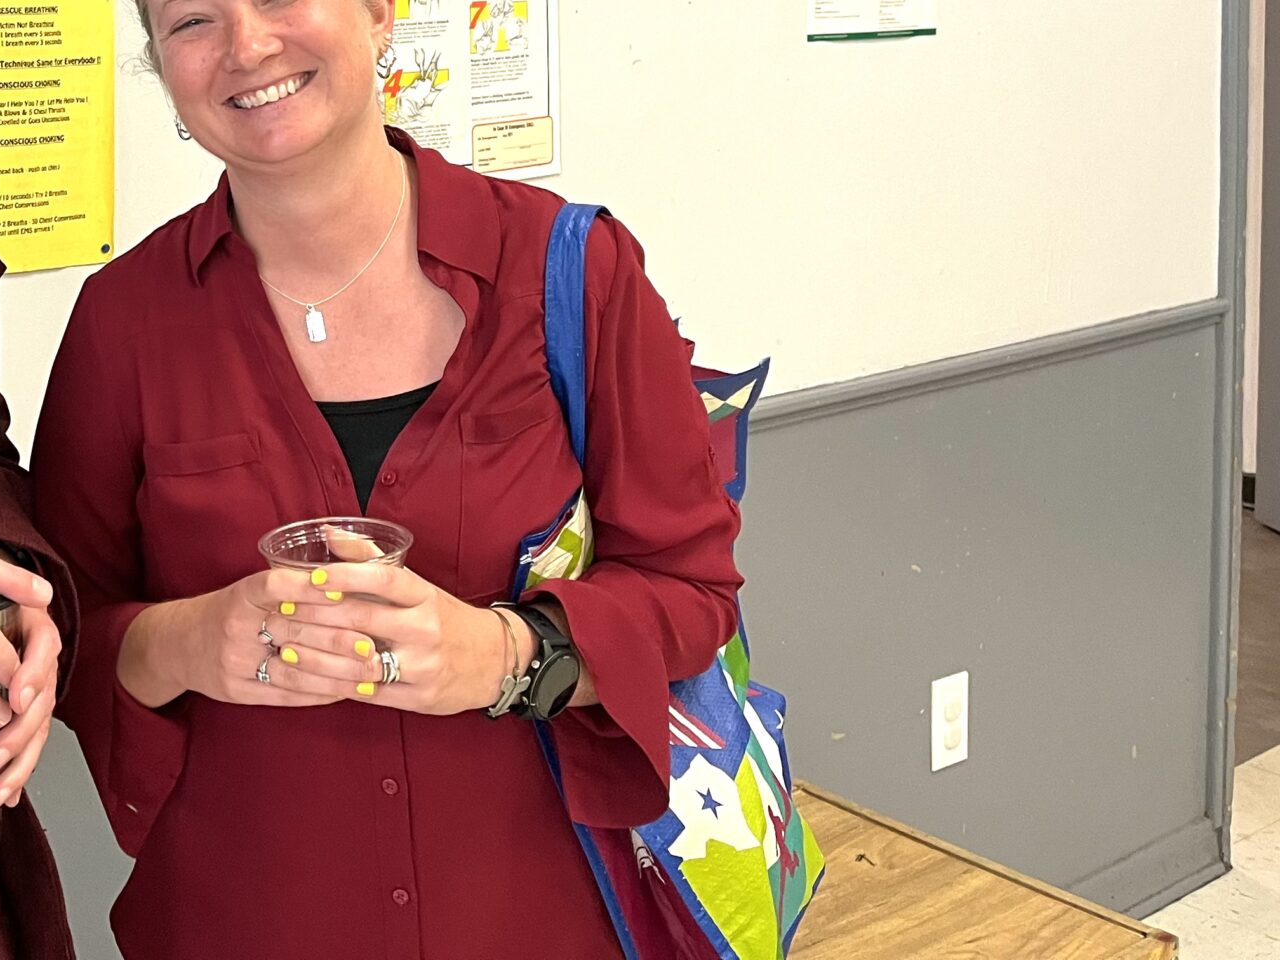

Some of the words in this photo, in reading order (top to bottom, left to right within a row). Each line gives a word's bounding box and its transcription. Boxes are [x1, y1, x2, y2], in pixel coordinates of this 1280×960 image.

[24, 6, 58, 14] BREATHING
[470, 1, 487, 29] 7
[0, 60, 34, 68] Technique
[37, 59, 53, 67] Same
[65, 57, 95, 65] Everybody
[35, 79, 60, 87] CHOKING
[383, 70, 403, 98] 4
[39, 135, 64, 144] CHOKING
[15, 200, 49, 209] Compressions
[54, 214, 86, 222] Compressions
